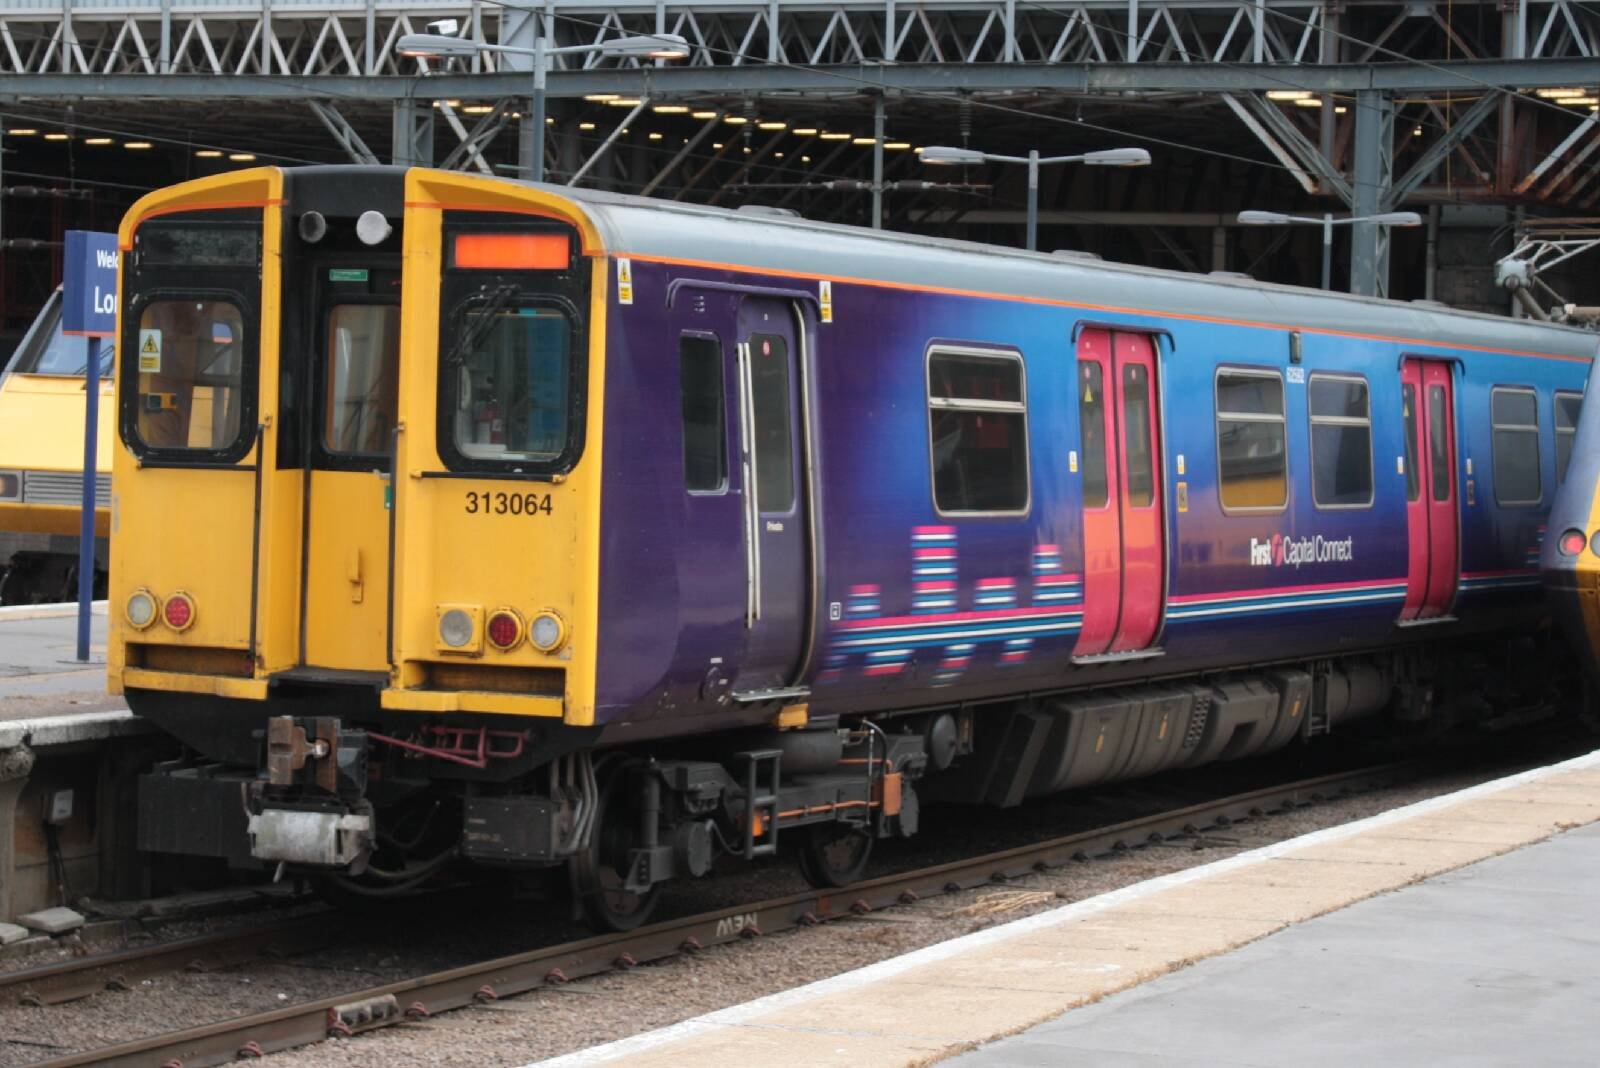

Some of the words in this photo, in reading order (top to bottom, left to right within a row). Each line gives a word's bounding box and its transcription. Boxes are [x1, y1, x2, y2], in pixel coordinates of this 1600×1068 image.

[465, 491, 553, 516] 313064
[1250, 537, 1272, 566] First
[1283, 535, 1315, 569] Capital
[1315, 534, 1353, 563] Connect
